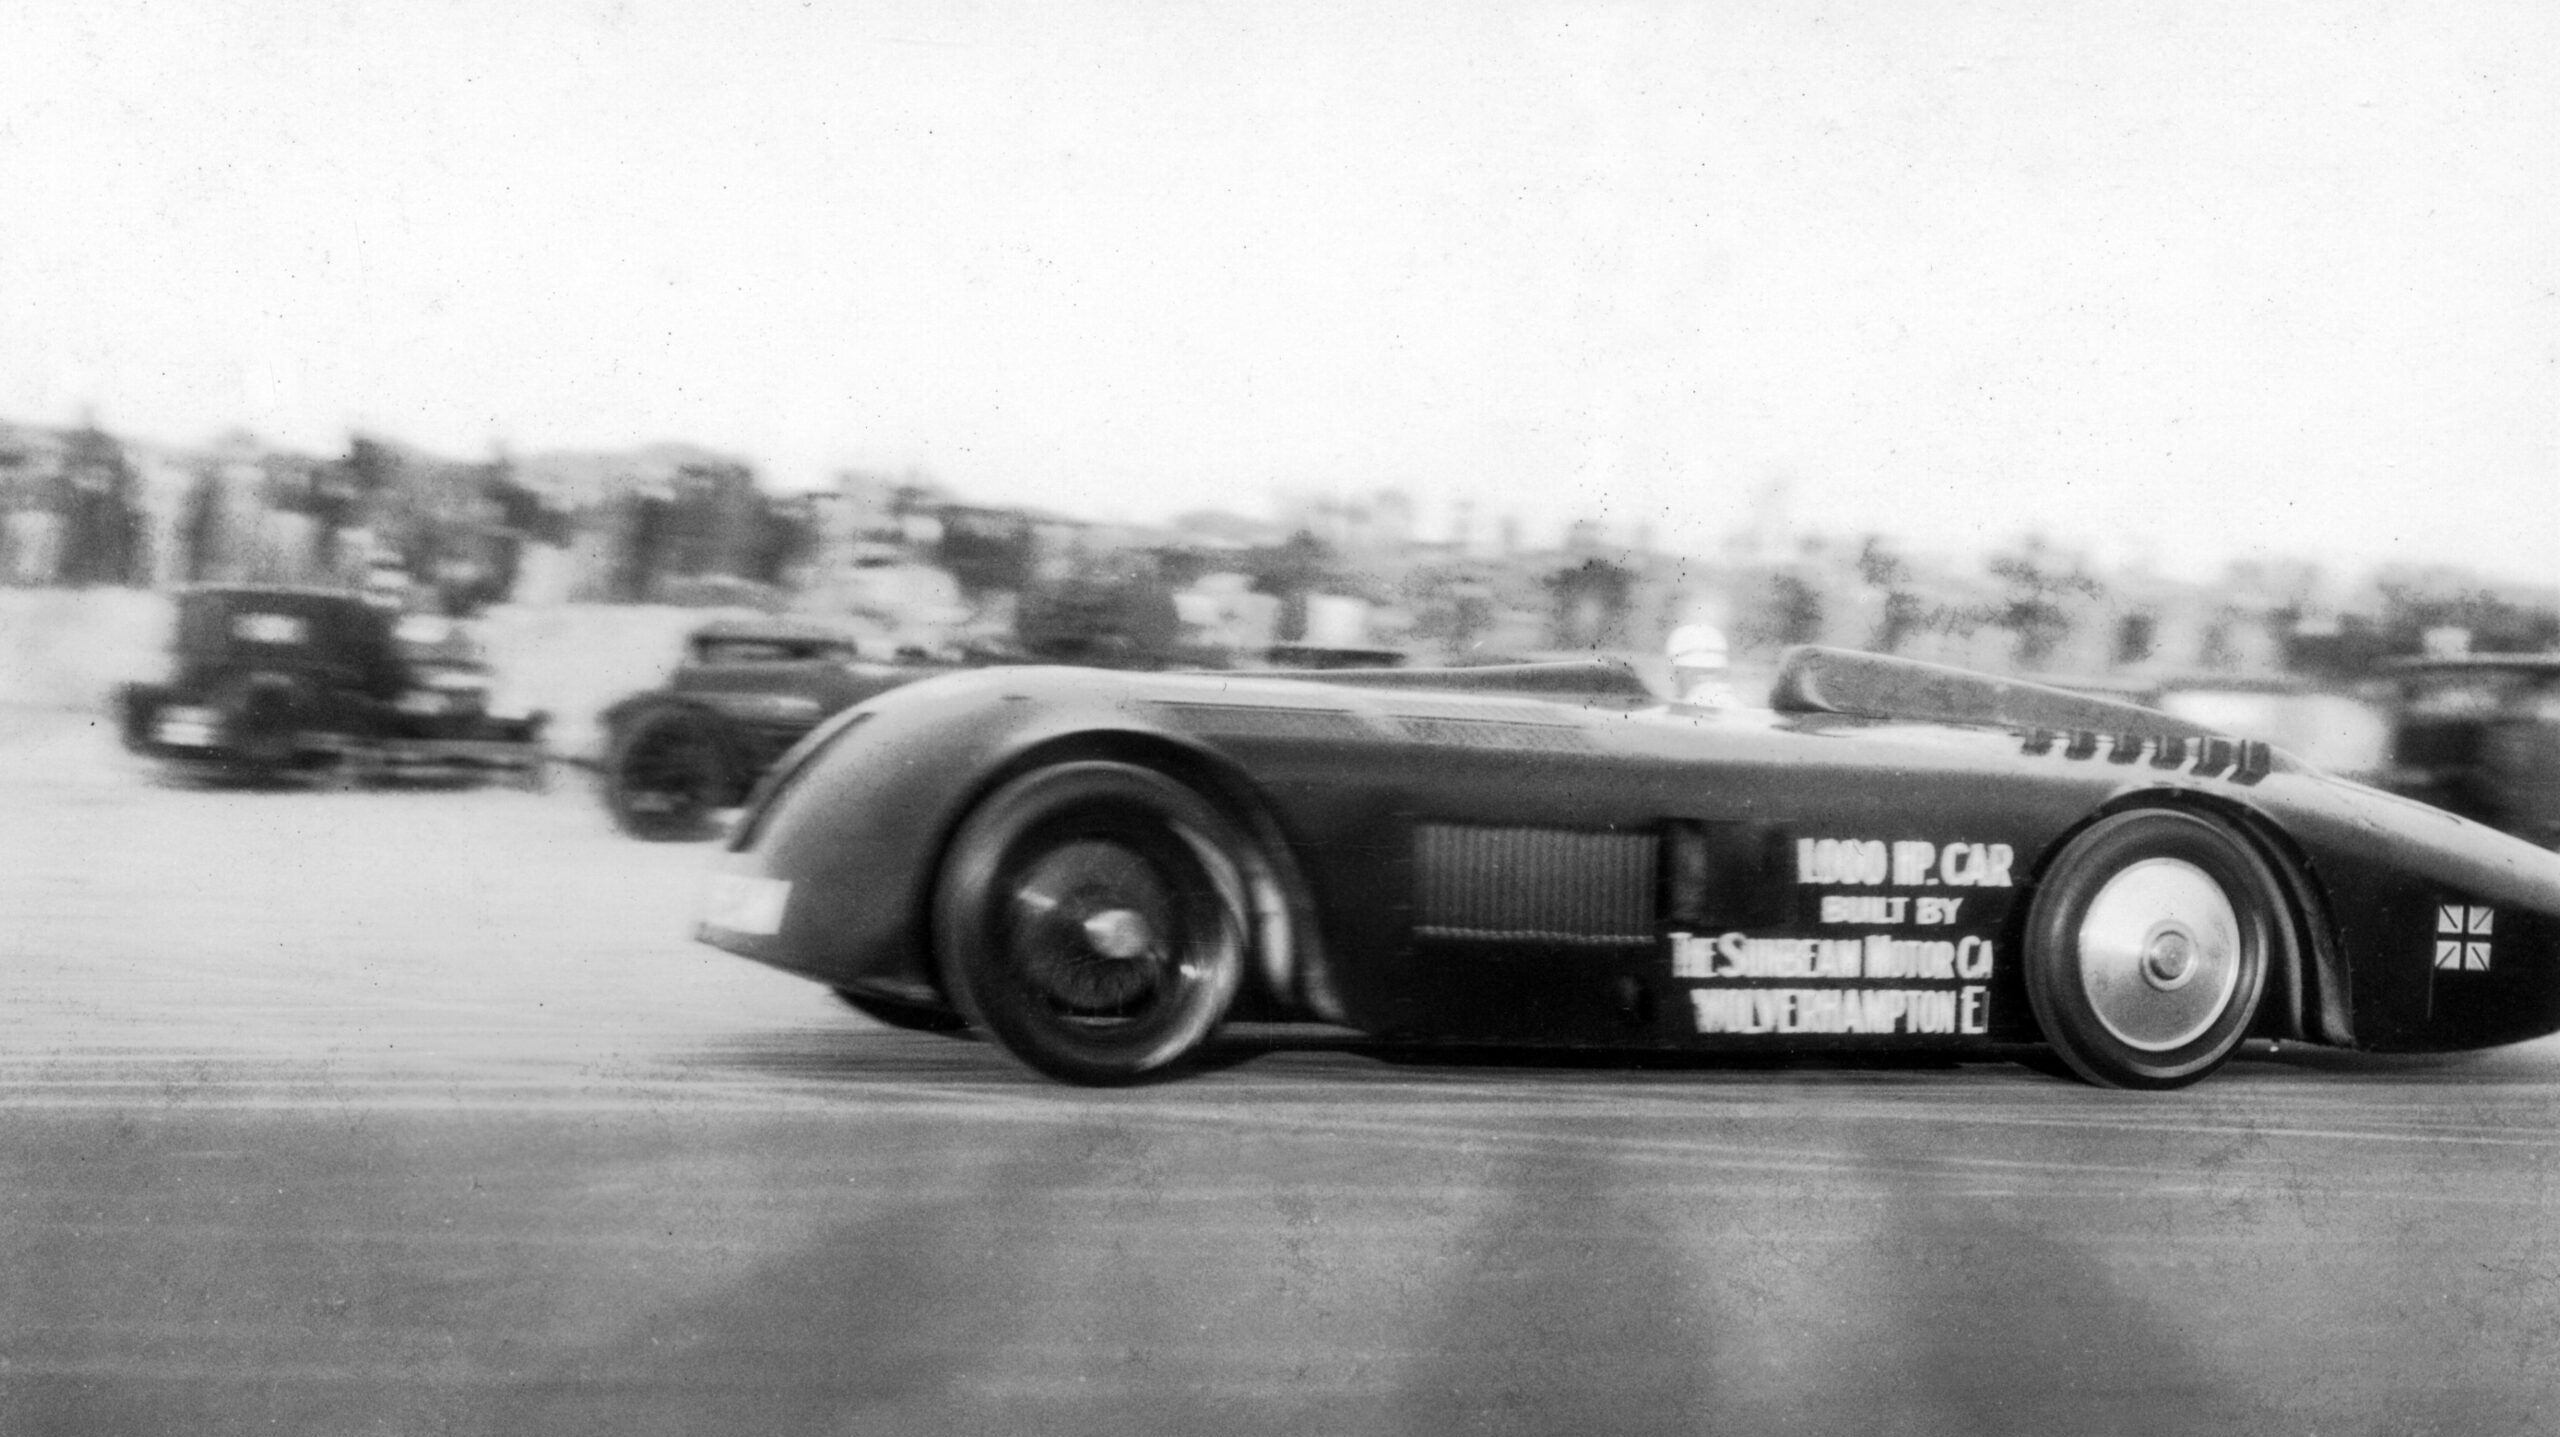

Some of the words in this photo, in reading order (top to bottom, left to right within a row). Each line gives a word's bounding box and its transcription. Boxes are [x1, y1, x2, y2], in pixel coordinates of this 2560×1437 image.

[1940, 842, 2014, 887] CAR
[1820, 896, 1910, 924] BUILT
[1915, 896, 1964, 925] BY
[1669, 932, 1718, 978] THE
[1717, 932, 1862, 979] SUNBEAM
[1864, 934, 1956, 980] MOTOR
[1690, 987, 1957, 1034] WOLVERHAMPTON
